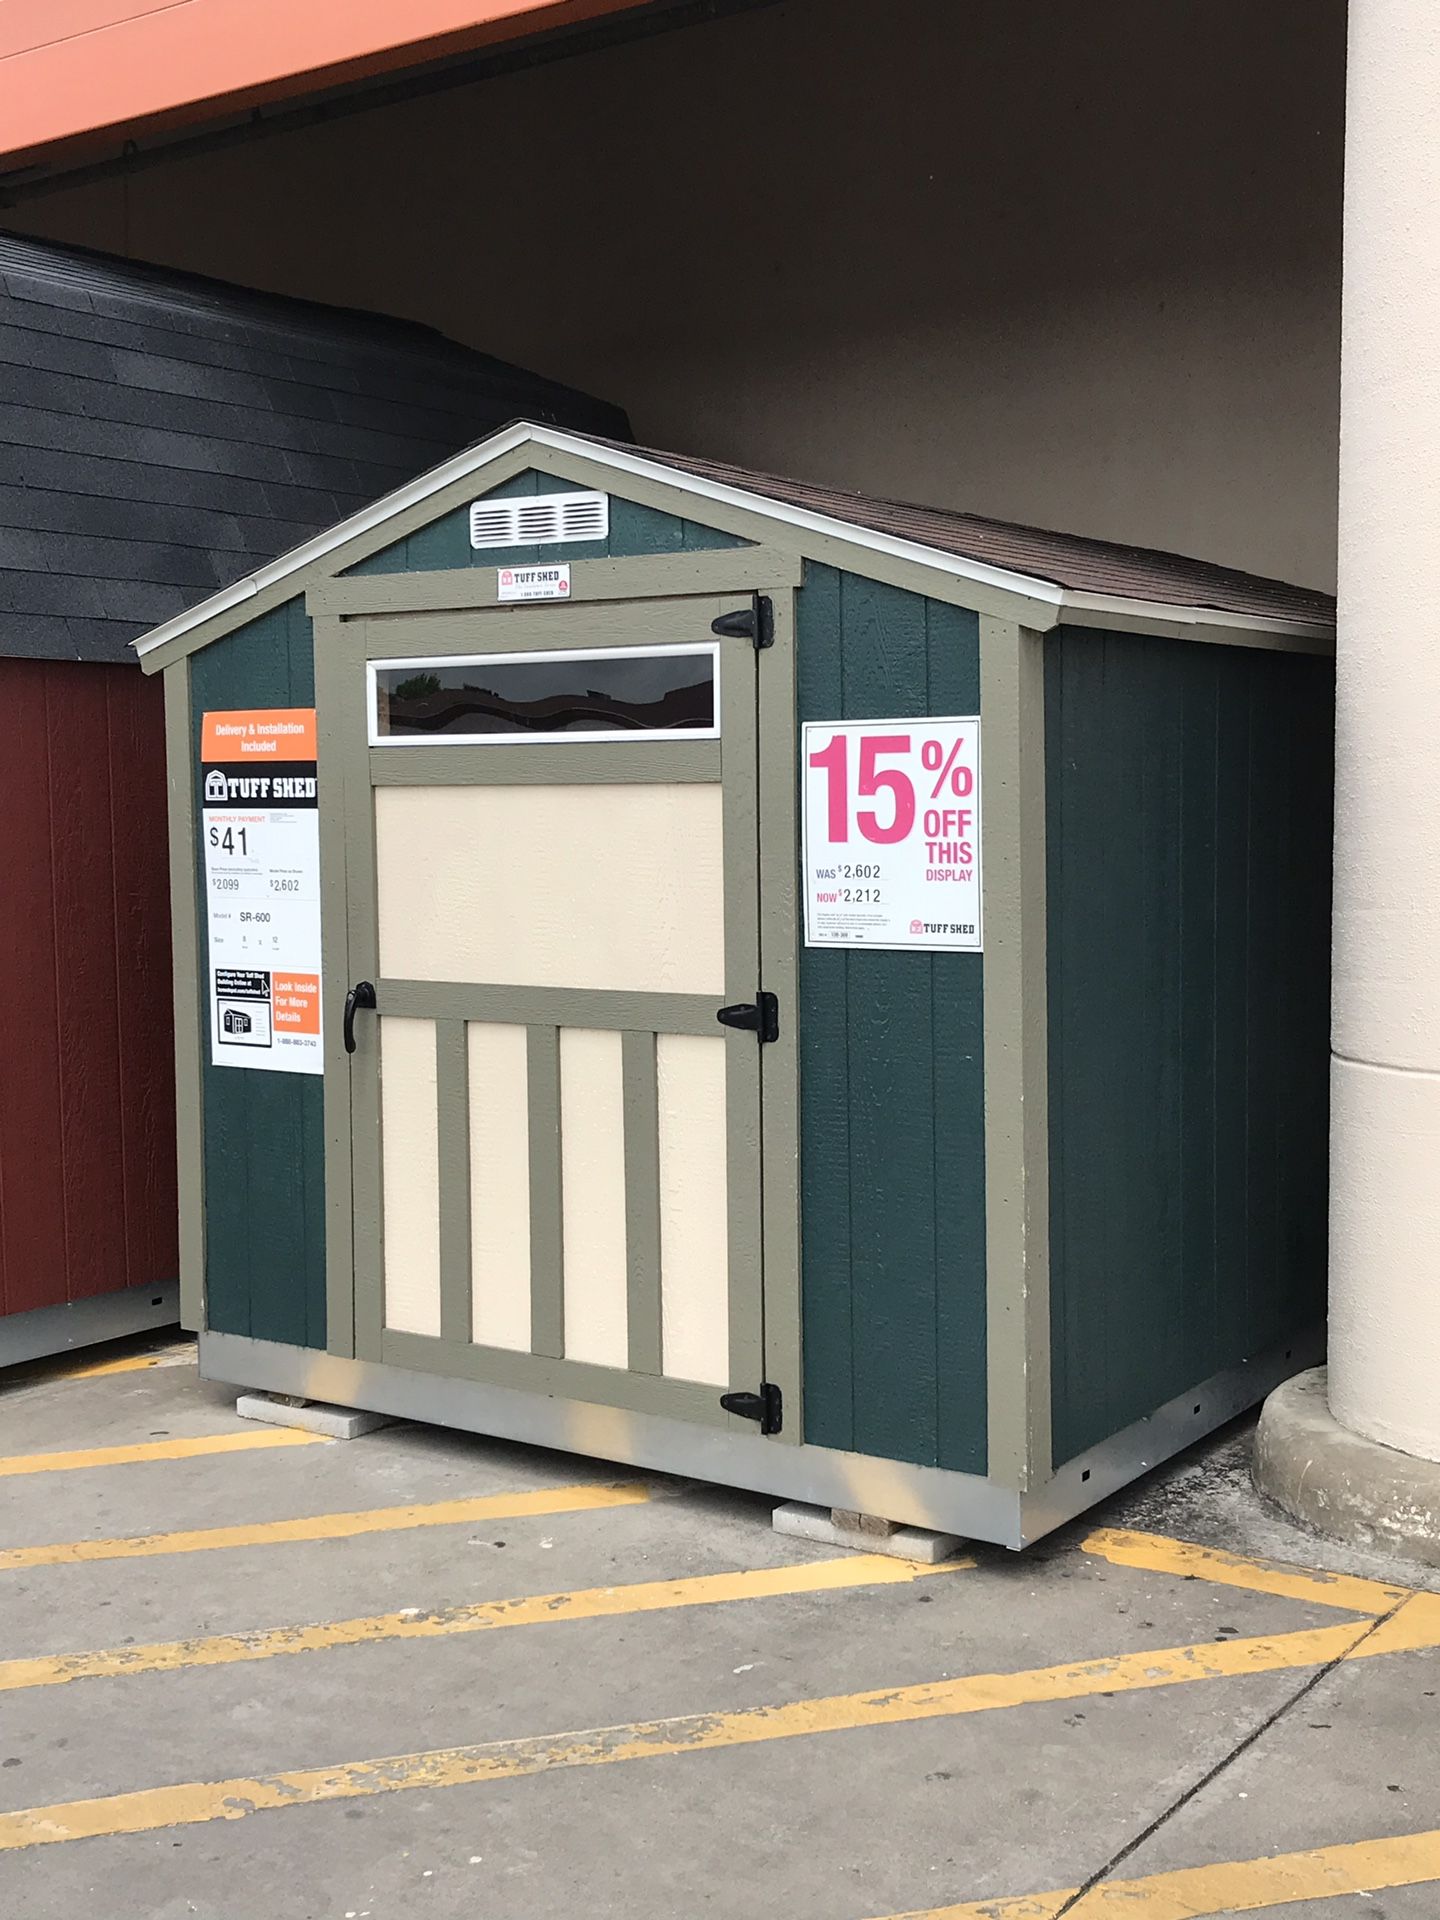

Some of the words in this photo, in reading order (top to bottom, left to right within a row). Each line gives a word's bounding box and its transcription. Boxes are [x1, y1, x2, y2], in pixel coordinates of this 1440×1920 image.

[514, 572, 536, 583] TUFF
[538, 571, 559, 581] SHED
[215, 724, 247, 737] Delivery
[248, 724, 256, 735] &
[257, 722, 304, 735] Installation
[241, 740, 277, 752] Included
[227, 778, 270, 798] TUFF
[273, 778, 316, 798] SHED
[923, 809, 972, 838] OFF
[210, 826, 247, 856] $41
[925, 841, 972, 864] THIS
[816, 869, 836, 879] WAS
[926, 869, 973, 882] DISPLAY
[816, 892, 837, 903] NOW
[239, 912, 271, 922] SR-600
[923, 923, 949, 934] TUFF
[950, 924, 975, 934] SHED
[275, 981, 293, 993] Look
[294, 982, 317, 993] Inside
[275, 996, 288, 1007] For
[289, 997, 308, 1008] More
[275, 1011, 301, 1022] Details
